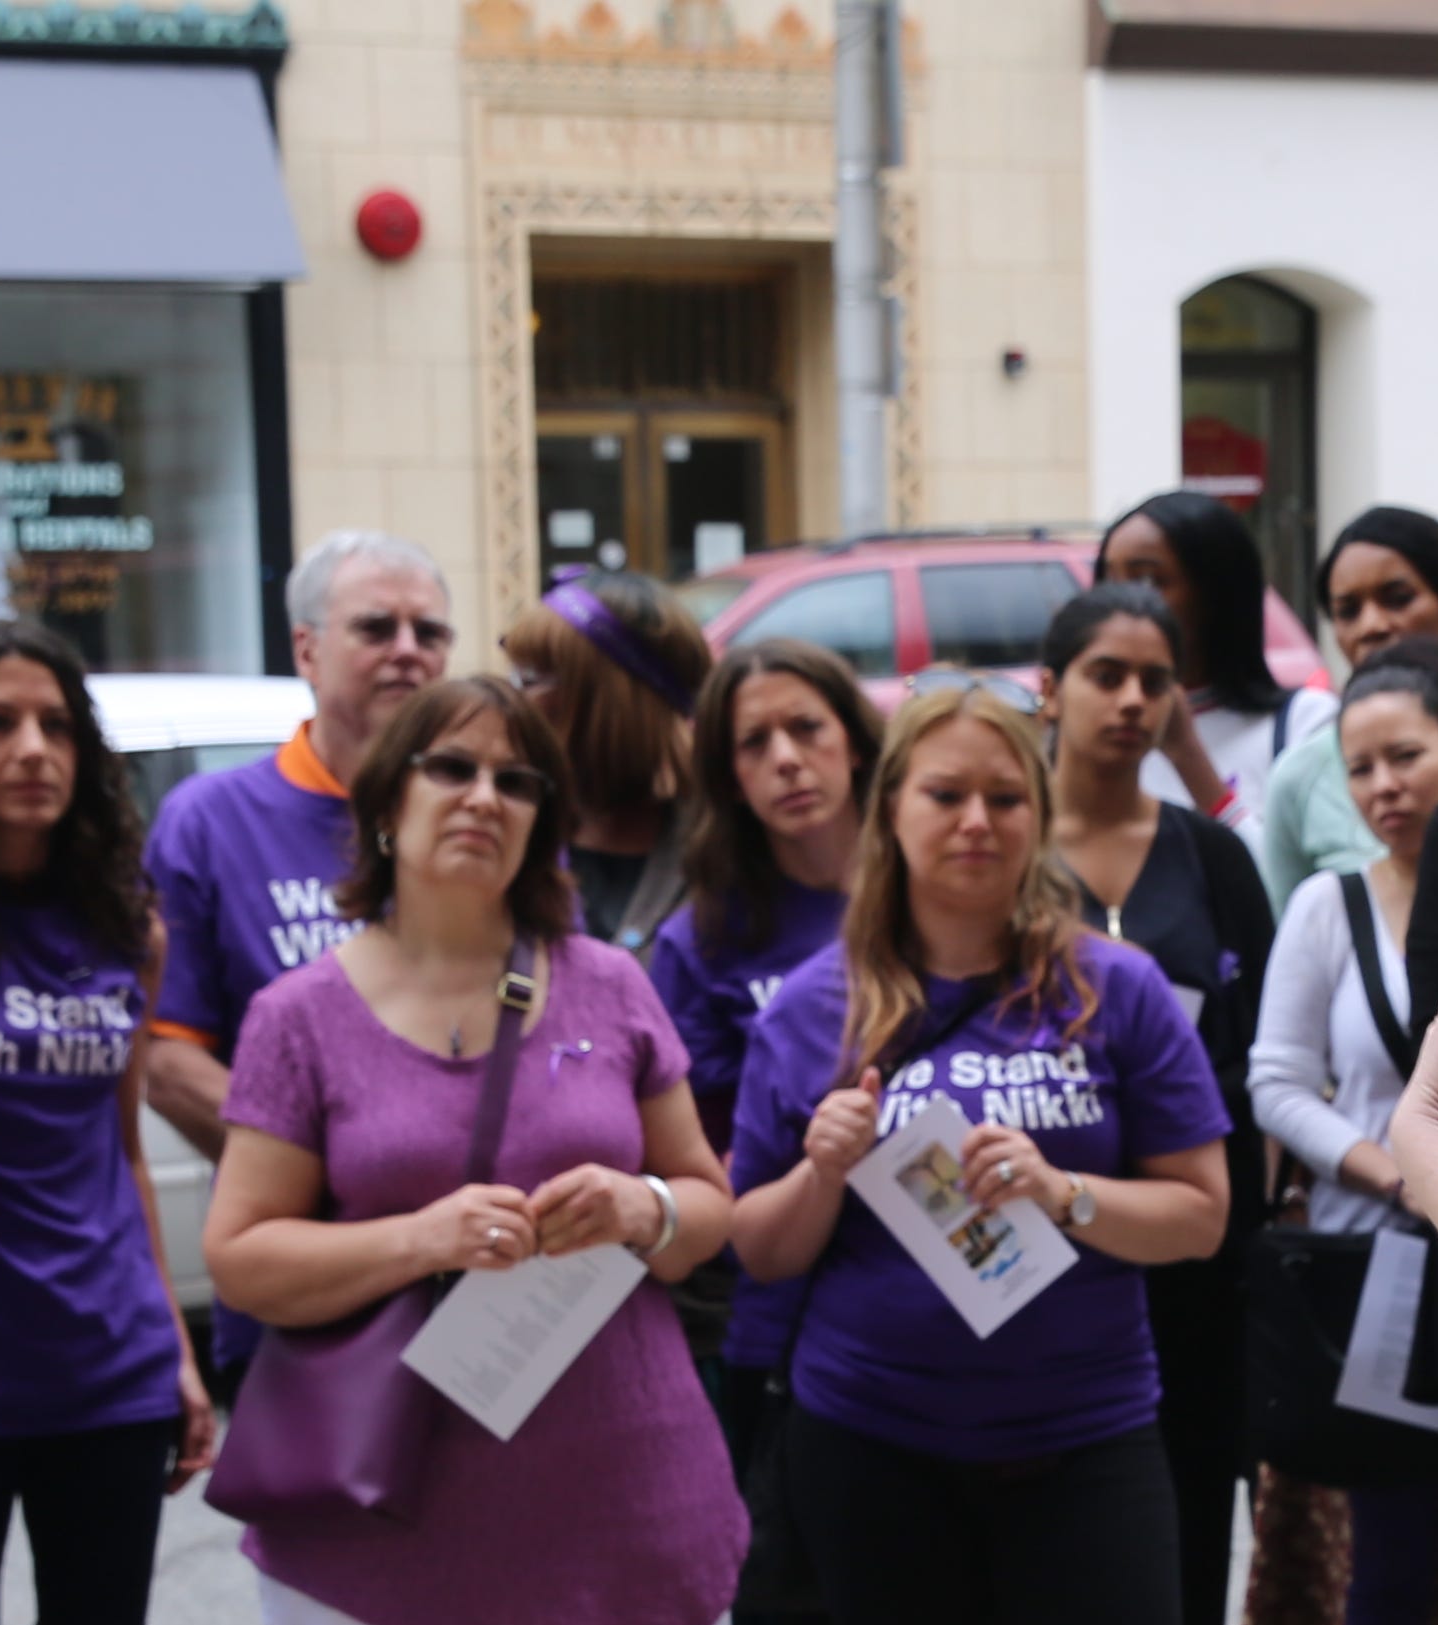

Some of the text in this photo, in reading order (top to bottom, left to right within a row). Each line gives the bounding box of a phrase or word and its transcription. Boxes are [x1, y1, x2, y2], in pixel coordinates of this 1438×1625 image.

[36, 1030, 131, 1076] Nik
[887, 1043, 1089, 1092] e Stand
[982, 1081, 1104, 1131] Nikki
